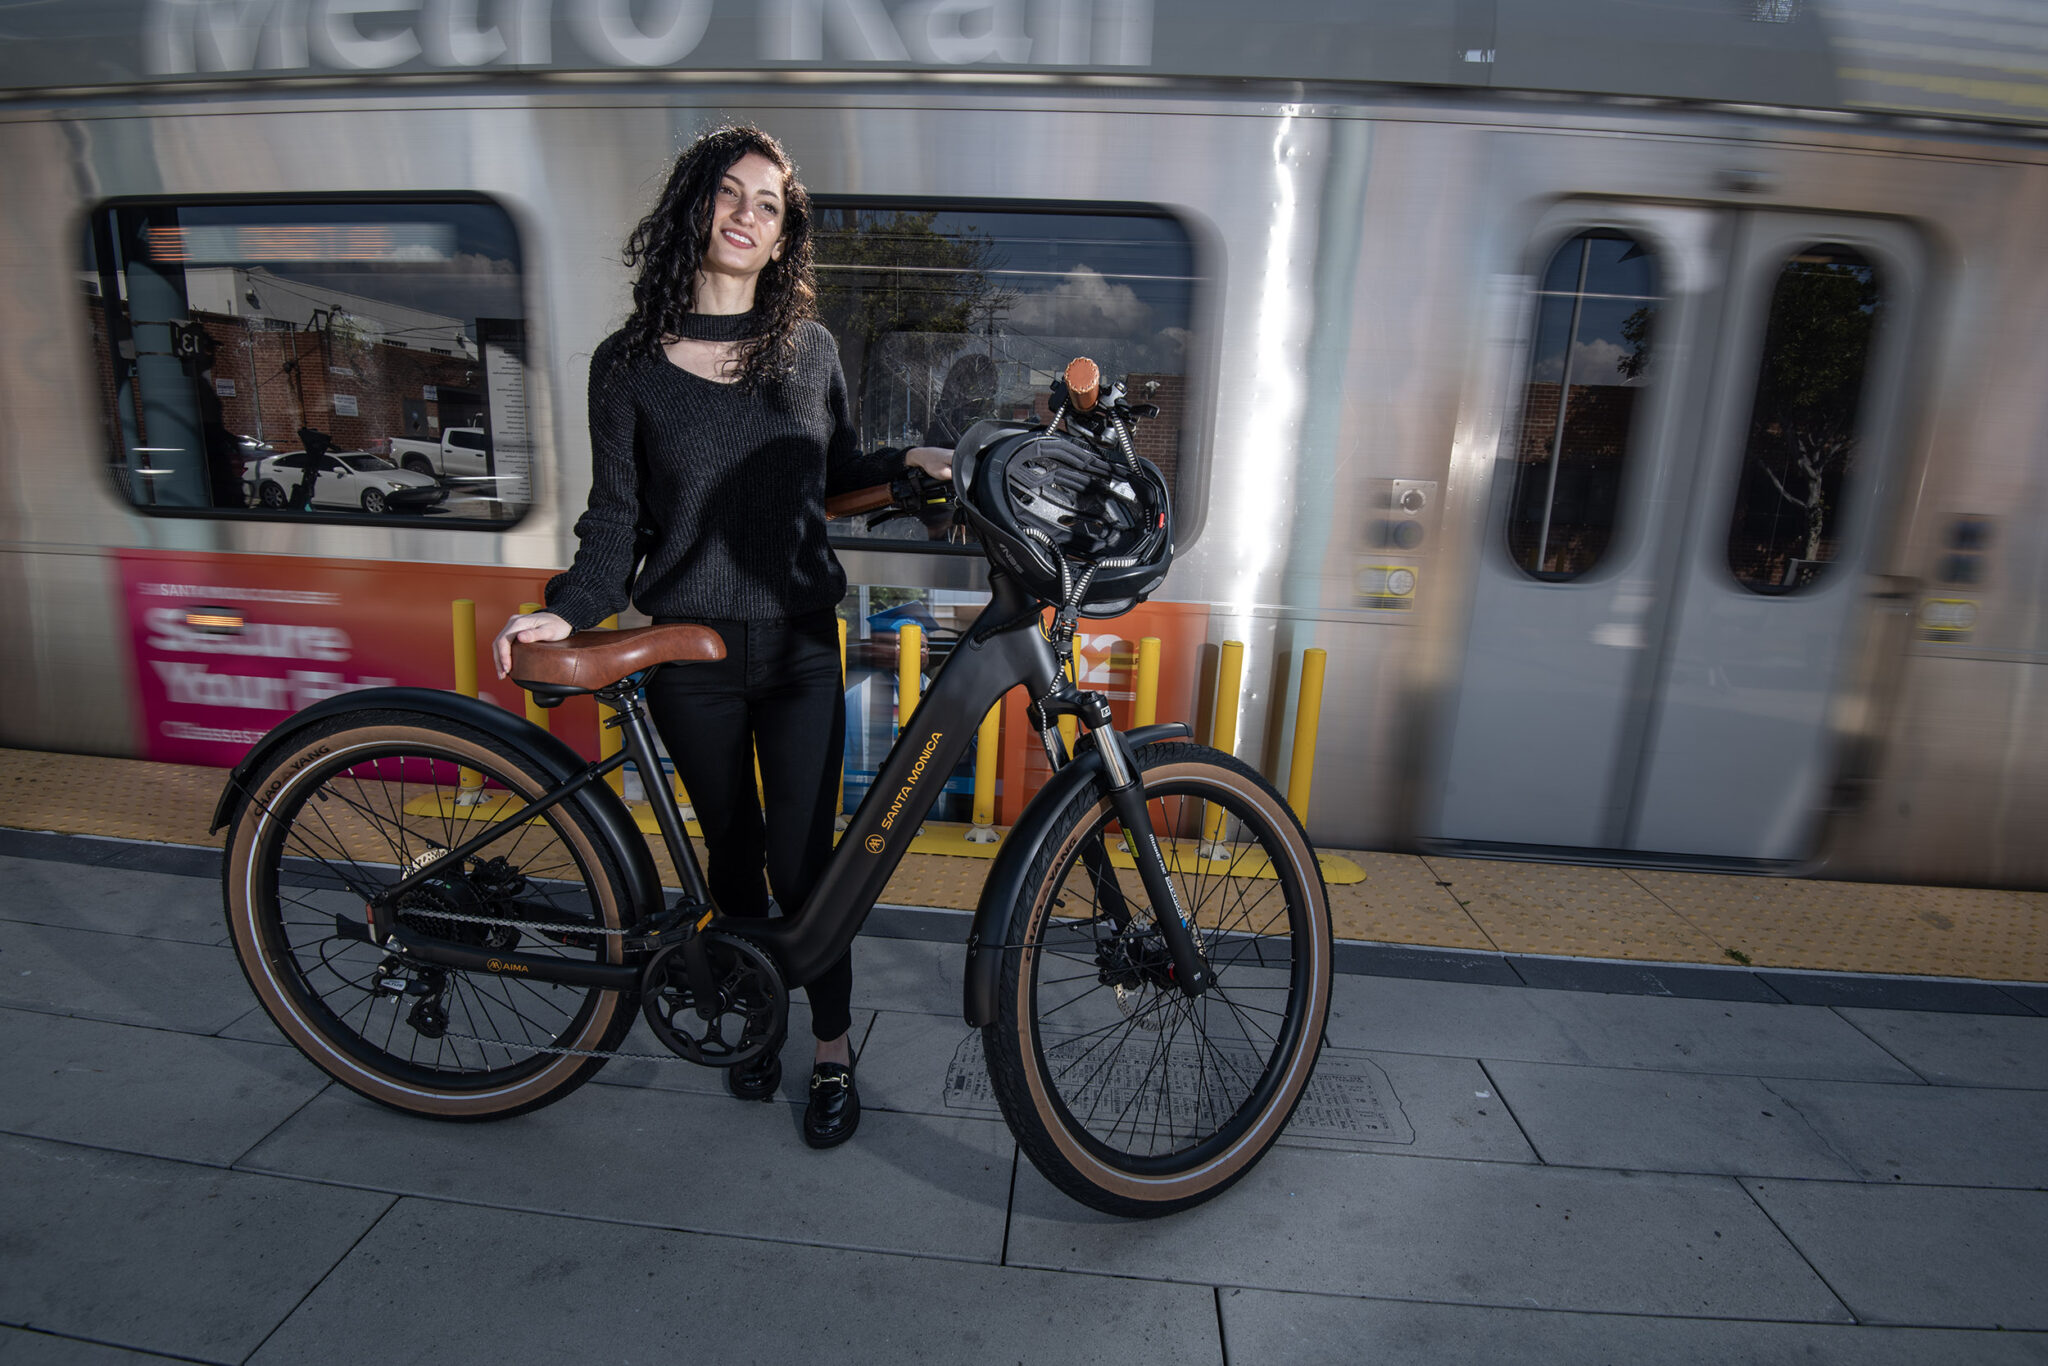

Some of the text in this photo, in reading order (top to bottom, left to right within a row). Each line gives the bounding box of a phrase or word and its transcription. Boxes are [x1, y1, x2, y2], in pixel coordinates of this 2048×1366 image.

[144, 607, 351, 662] Sure
[291, 745, 330, 770] YANG
[881, 731, 943, 831] SANTA MONICA
[502, 962, 529, 973] AIMA
